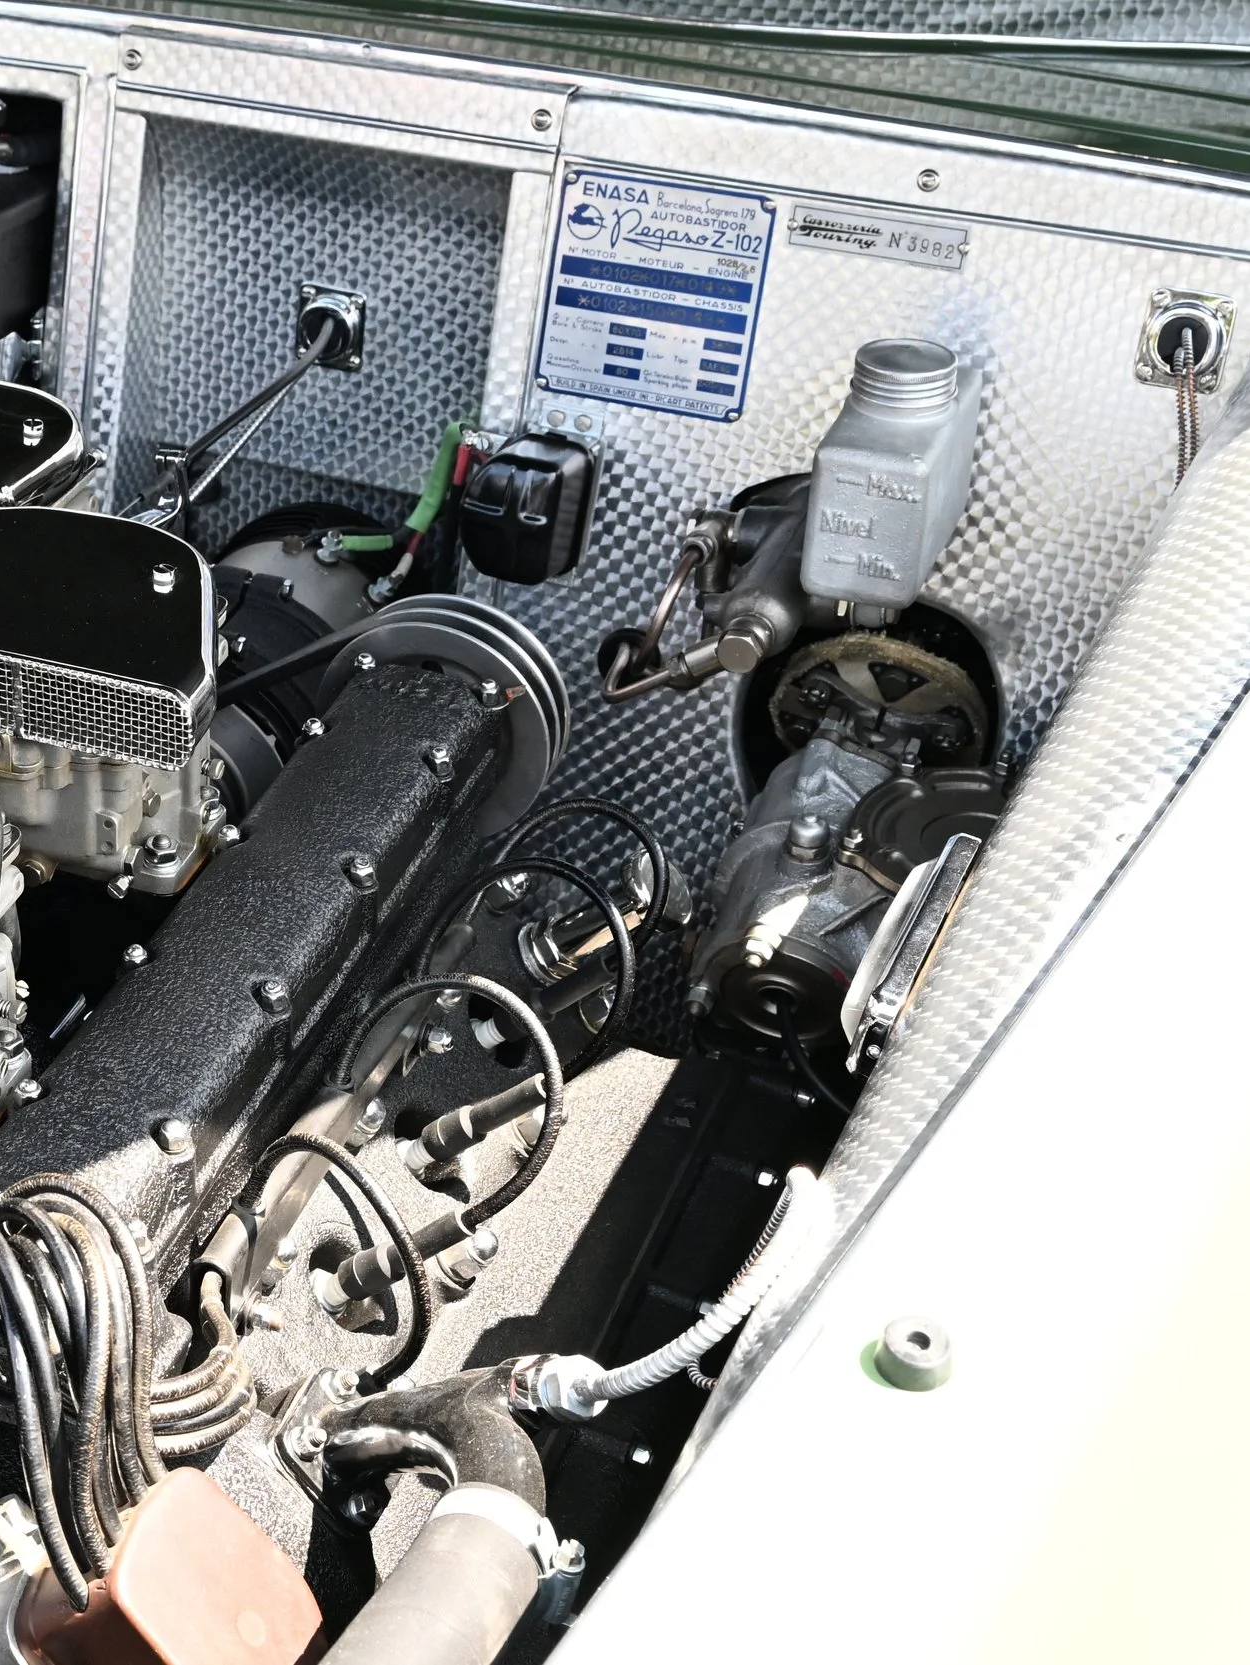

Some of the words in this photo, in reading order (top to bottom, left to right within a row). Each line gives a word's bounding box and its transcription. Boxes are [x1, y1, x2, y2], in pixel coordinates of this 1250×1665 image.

[582, 181, 650, 205] ENASA
[656, 191, 703, 213] Barcelona,
[703, 198, 739, 218] Sagrera
[740, 206, 757, 221] 179
[610, 207, 709, 252] Pegaso
[710, 230, 763, 254] Z-102
[650, 210, 747, 232] AUTOBASTIDOR
[802, 214, 883, 235] Carrozzeria
[907, 235, 955, 260] 3982
[582, 248, 617, 260] MOTOR
[639, 256, 685, 270] MOTEUR
[708, 266, 748, 280] ENGINE
[581, 281, 677, 302] AUTOBASTIDOR
[694, 296, 744, 312] CHASSIS
[556, 377, 577, 388] BUILD
[590, 383, 611, 394] SPAIN
[613, 387, 636, 398] UNDER
[685, 398, 720, 412] PATENTS
[820, 508, 876, 540] Nivel
